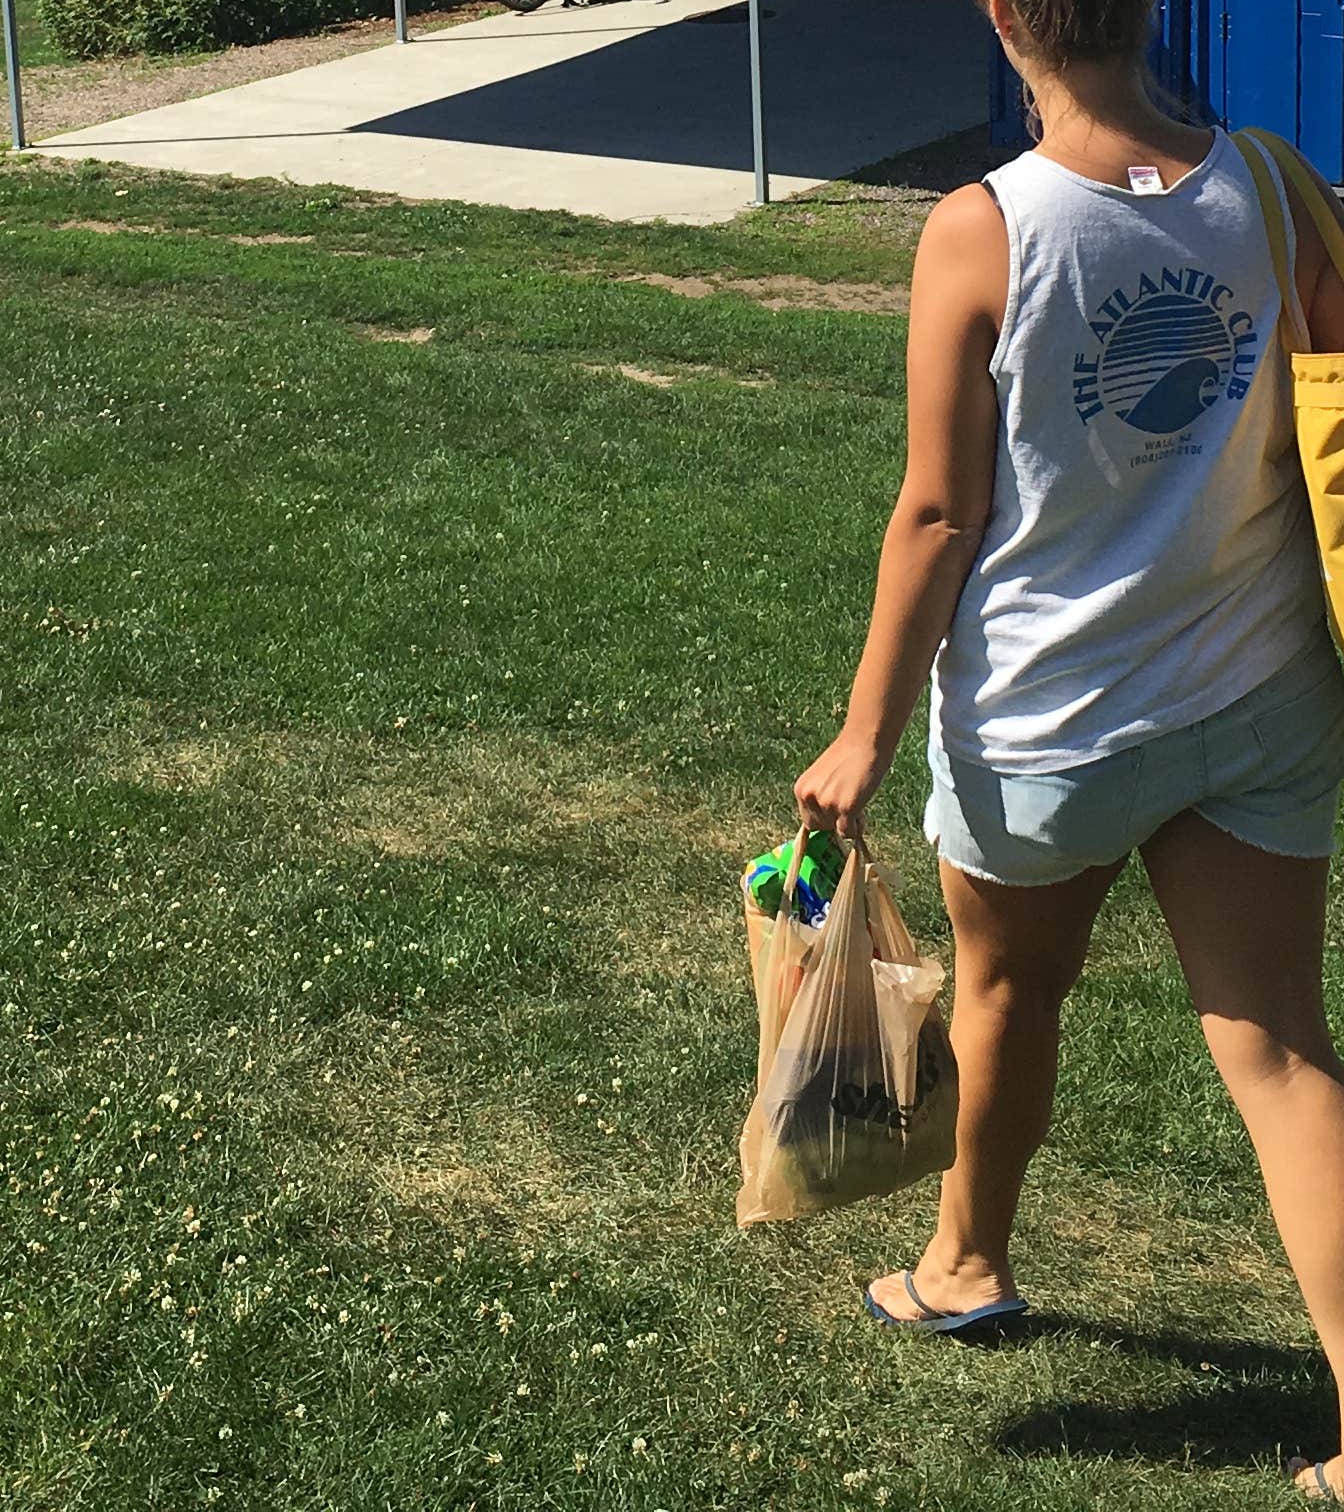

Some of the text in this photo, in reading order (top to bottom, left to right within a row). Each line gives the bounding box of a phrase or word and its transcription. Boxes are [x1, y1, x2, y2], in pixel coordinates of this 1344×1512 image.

[1072, 266, 1258, 426] THE ATLANTIC CLUB
